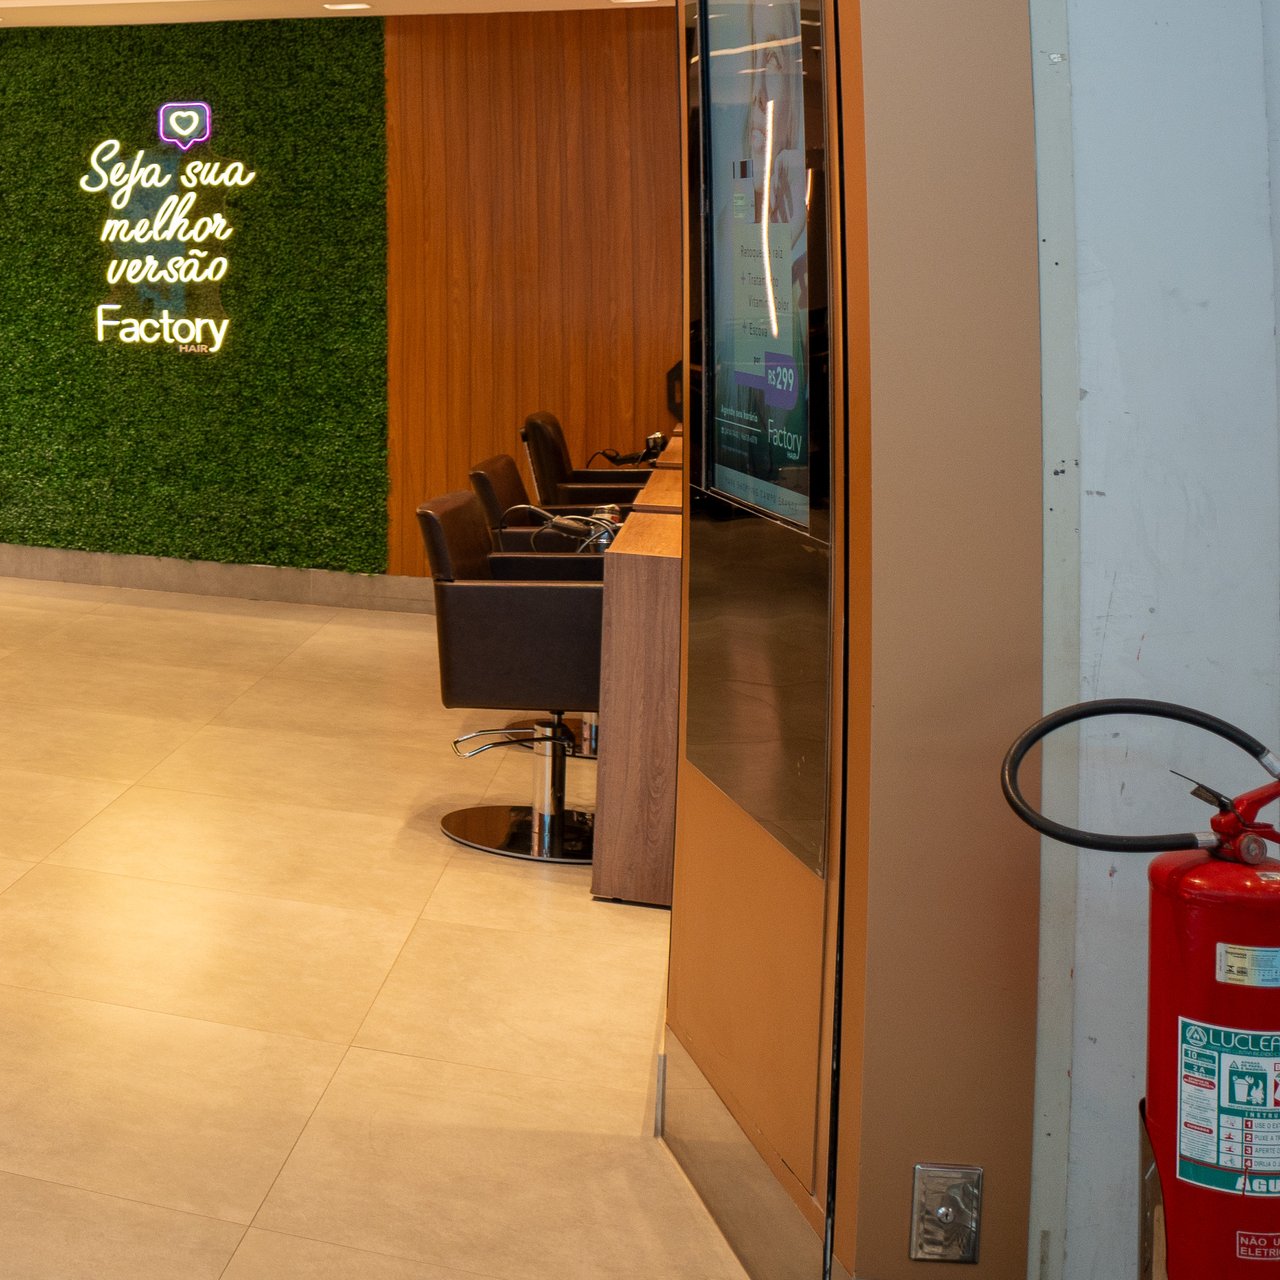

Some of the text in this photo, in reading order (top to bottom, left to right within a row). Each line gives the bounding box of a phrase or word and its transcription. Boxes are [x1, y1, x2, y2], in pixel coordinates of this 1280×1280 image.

[79, 139, 256, 210] Seja sua
[100, 192, 234, 243] melhor
[106, 248, 228, 285] versão
[96, 303, 230, 353] Factory
[179, 344, 208, 353] HAIR
[768, 419, 802, 460] Factory
